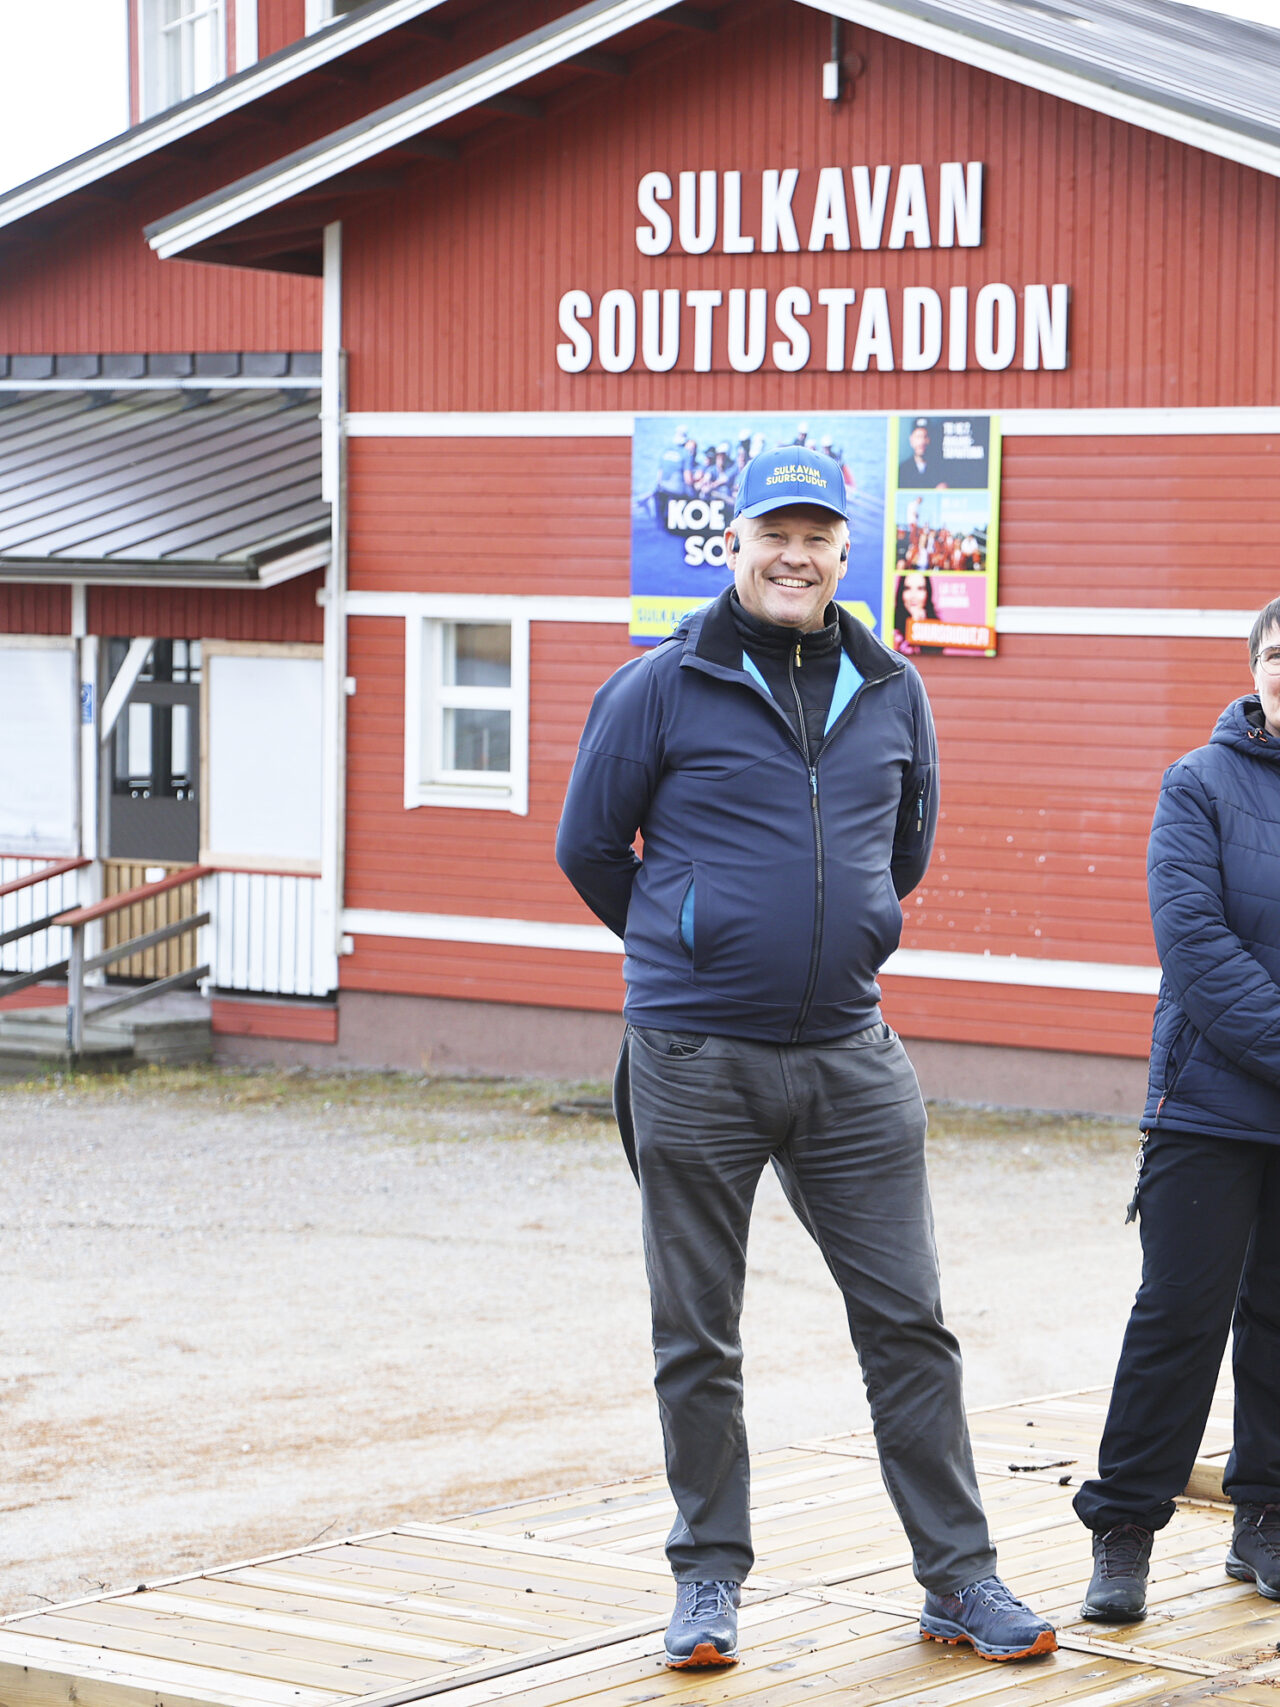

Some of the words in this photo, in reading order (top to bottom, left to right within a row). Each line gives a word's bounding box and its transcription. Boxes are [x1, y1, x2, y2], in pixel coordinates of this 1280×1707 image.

[635, 161, 985, 256] SULKAVAN
[555, 282, 1070, 374] SOUTUSTADION
[766, 473, 828, 489] SUURSOUDUT
[773, 464, 821, 478] SULKAVAN
[667, 499, 726, 531] KOE
